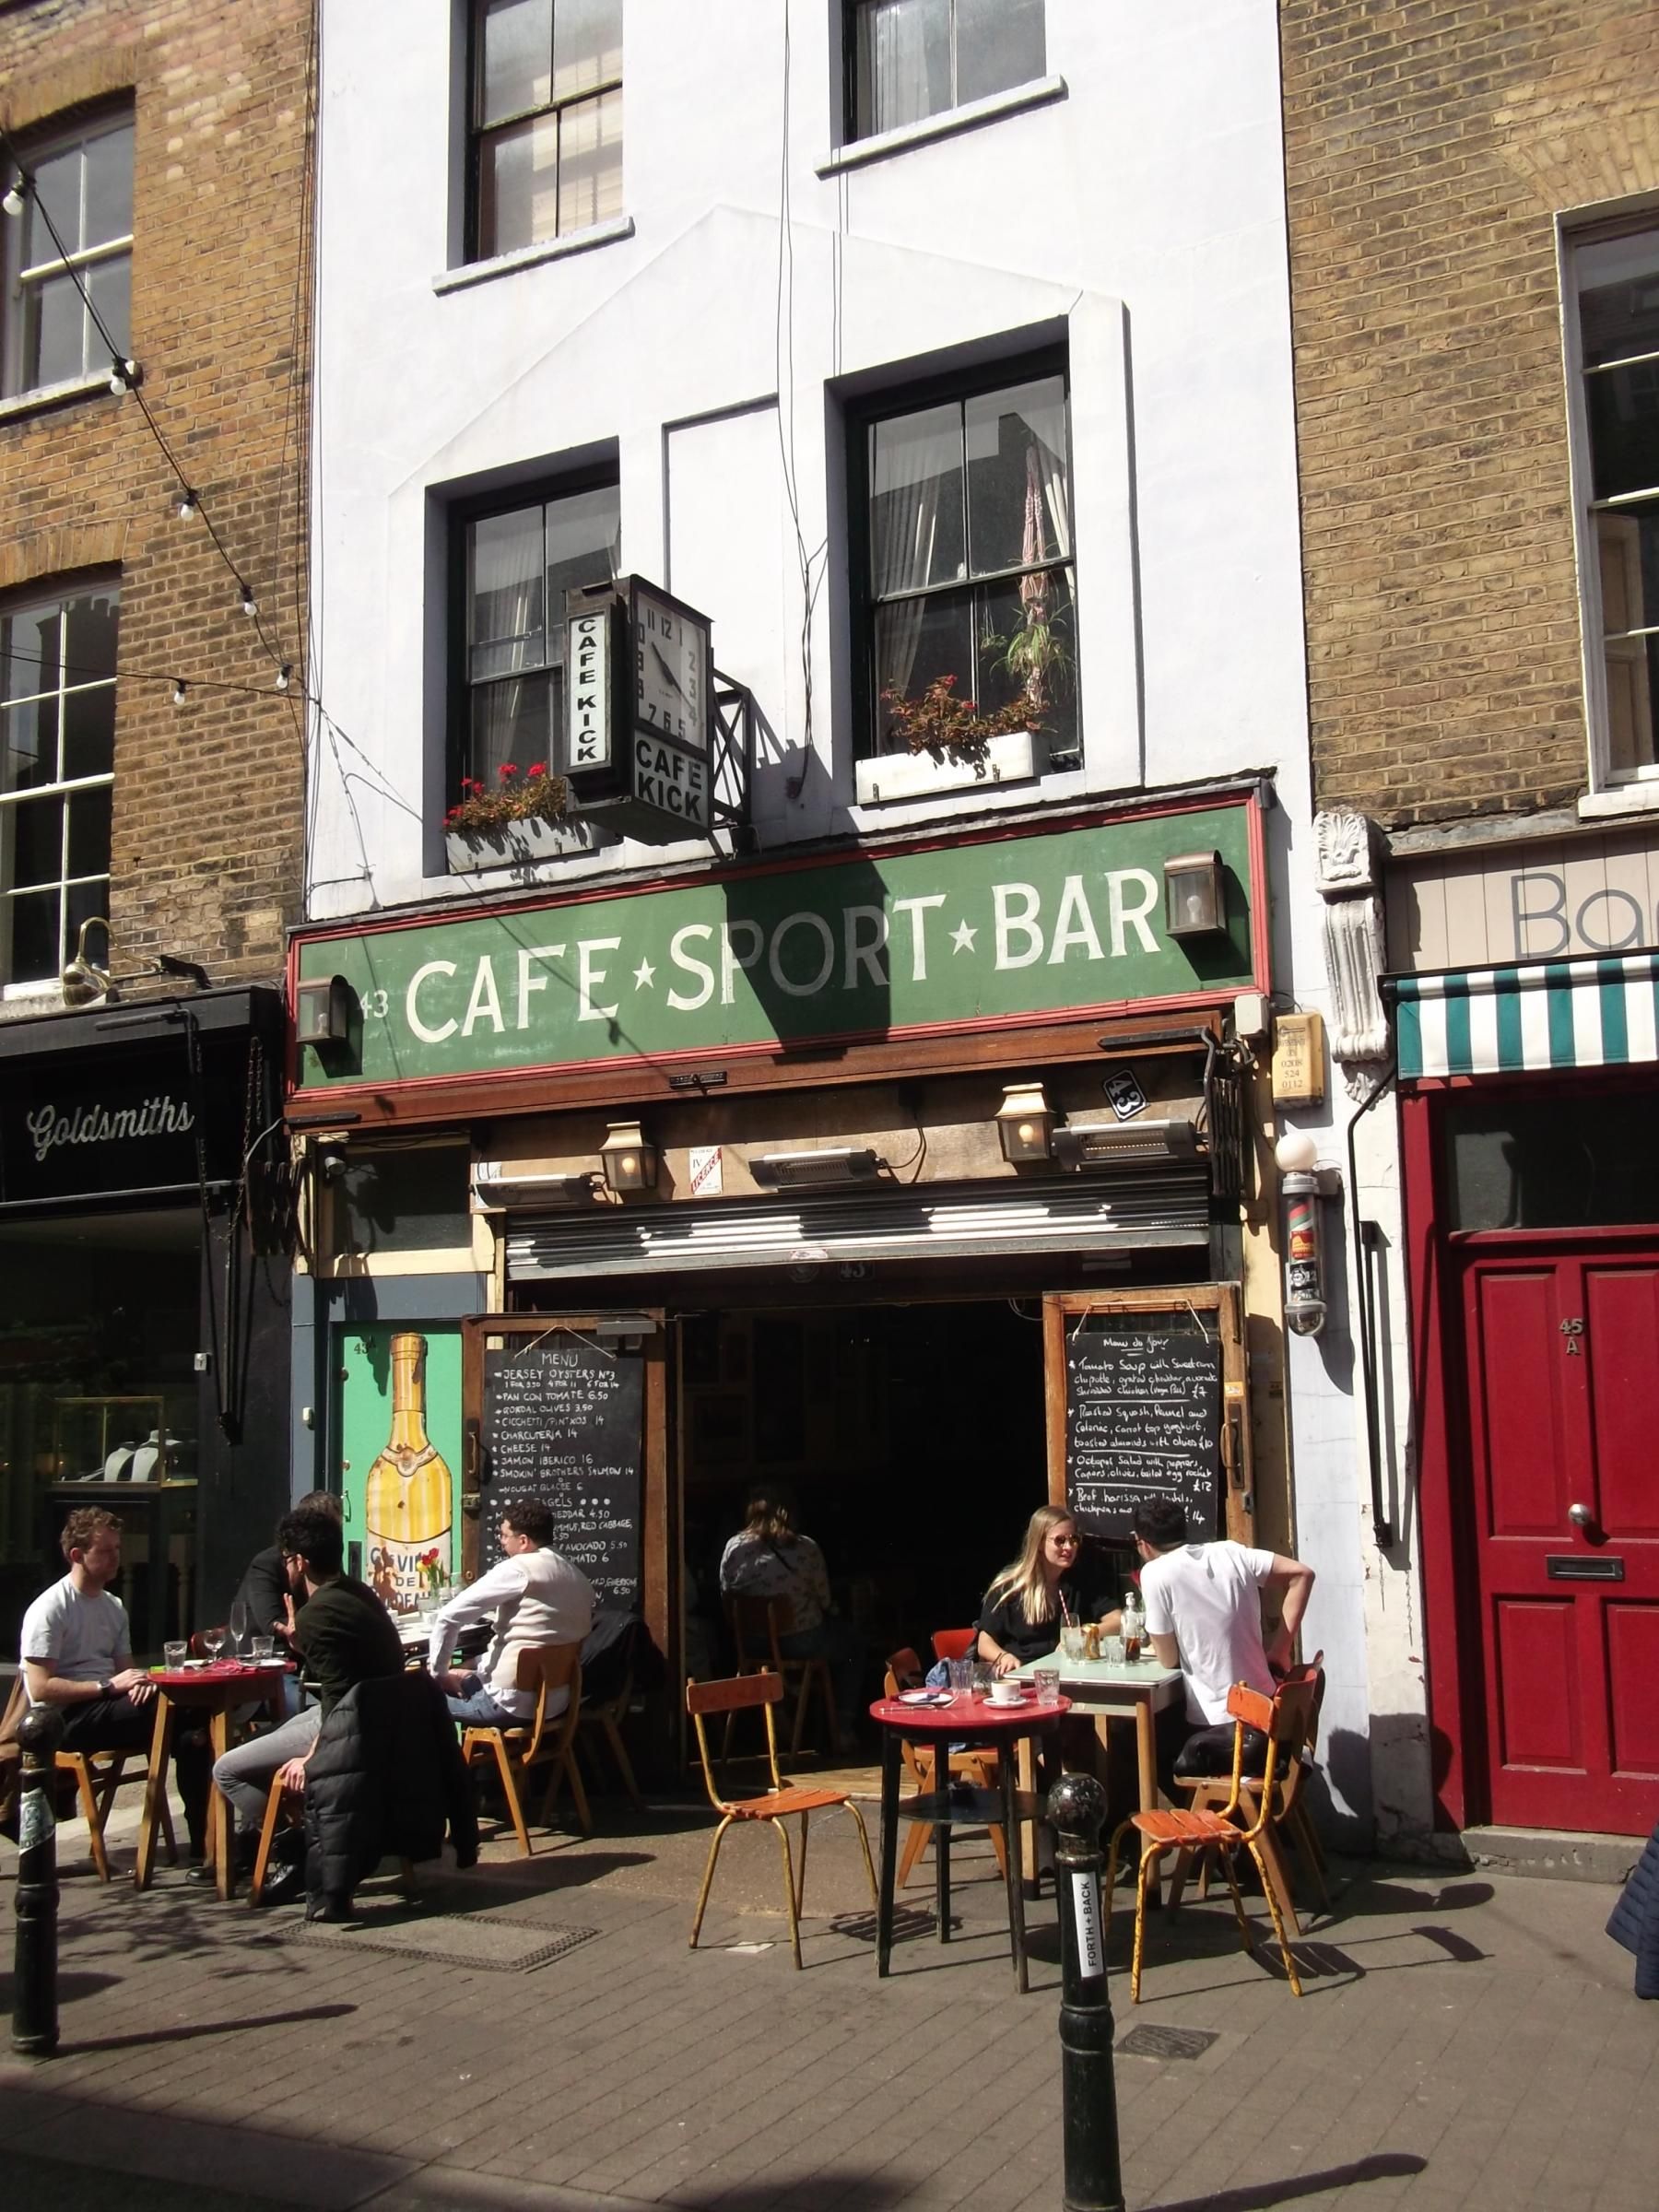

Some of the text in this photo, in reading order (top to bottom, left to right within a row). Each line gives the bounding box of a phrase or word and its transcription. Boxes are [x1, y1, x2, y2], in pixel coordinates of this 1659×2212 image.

[661, 616, 672, 641] 12
[688, 651, 696, 672] 2
[577, 618, 597, 761] CAFE KICK
[689, 677, 697, 700] 3
[649, 702, 657, 724] 7
[664, 711, 671, 733] 6
[678, 719, 686, 739] 5
[636, 739, 702, 791] CAFE
[638, 771, 701, 822] KICK
[1511, 872, 1659, 960] Ba
[406, 868, 1160, 1043] CAFE SPORT BAR
[359, 989, 389, 1019] 43
[1109, 1080, 1141, 1113] 43
[27, 1095, 195, 1162] Goldsmiths
[692, 1150, 719, 1192] LICENCE
[1559, 1318, 1584, 1335] 45
[1565, 1336, 1580, 1355] A
[542, 1353, 579, 1368] MENU
[1119, 1359, 1146, 1375] Soup
[503, 1370, 544, 1380] JERSEY
[548, 1370, 595, 1380] OYSTERS
[502, 1390, 608, 1402] PAN CON TOMATE 6.50
[539, 1404, 571, 1413] OLIVES
[568, 1428, 578, 1438] 14
[1145, 1422, 1160, 1435] top
[500, 1443, 537, 1454] CHEESE
[1074, 1436, 1107, 1448] toasted
[500, 1453, 594, 1465] JAMON IBERICO 16
[503, 1484, 537, 1493] NOUGAT
[576, 1482, 583, 1491] 6
[535, 1498, 573, 1508] AGELS
[552, 1510, 586, 1519] EDDAR
[602, 1552, 609, 1562] 6
[395, 1576, 416, 1587] DE
[1081, 1881, 1092, 1915] BACK
[1085, 1926, 1097, 1967] FORTH
